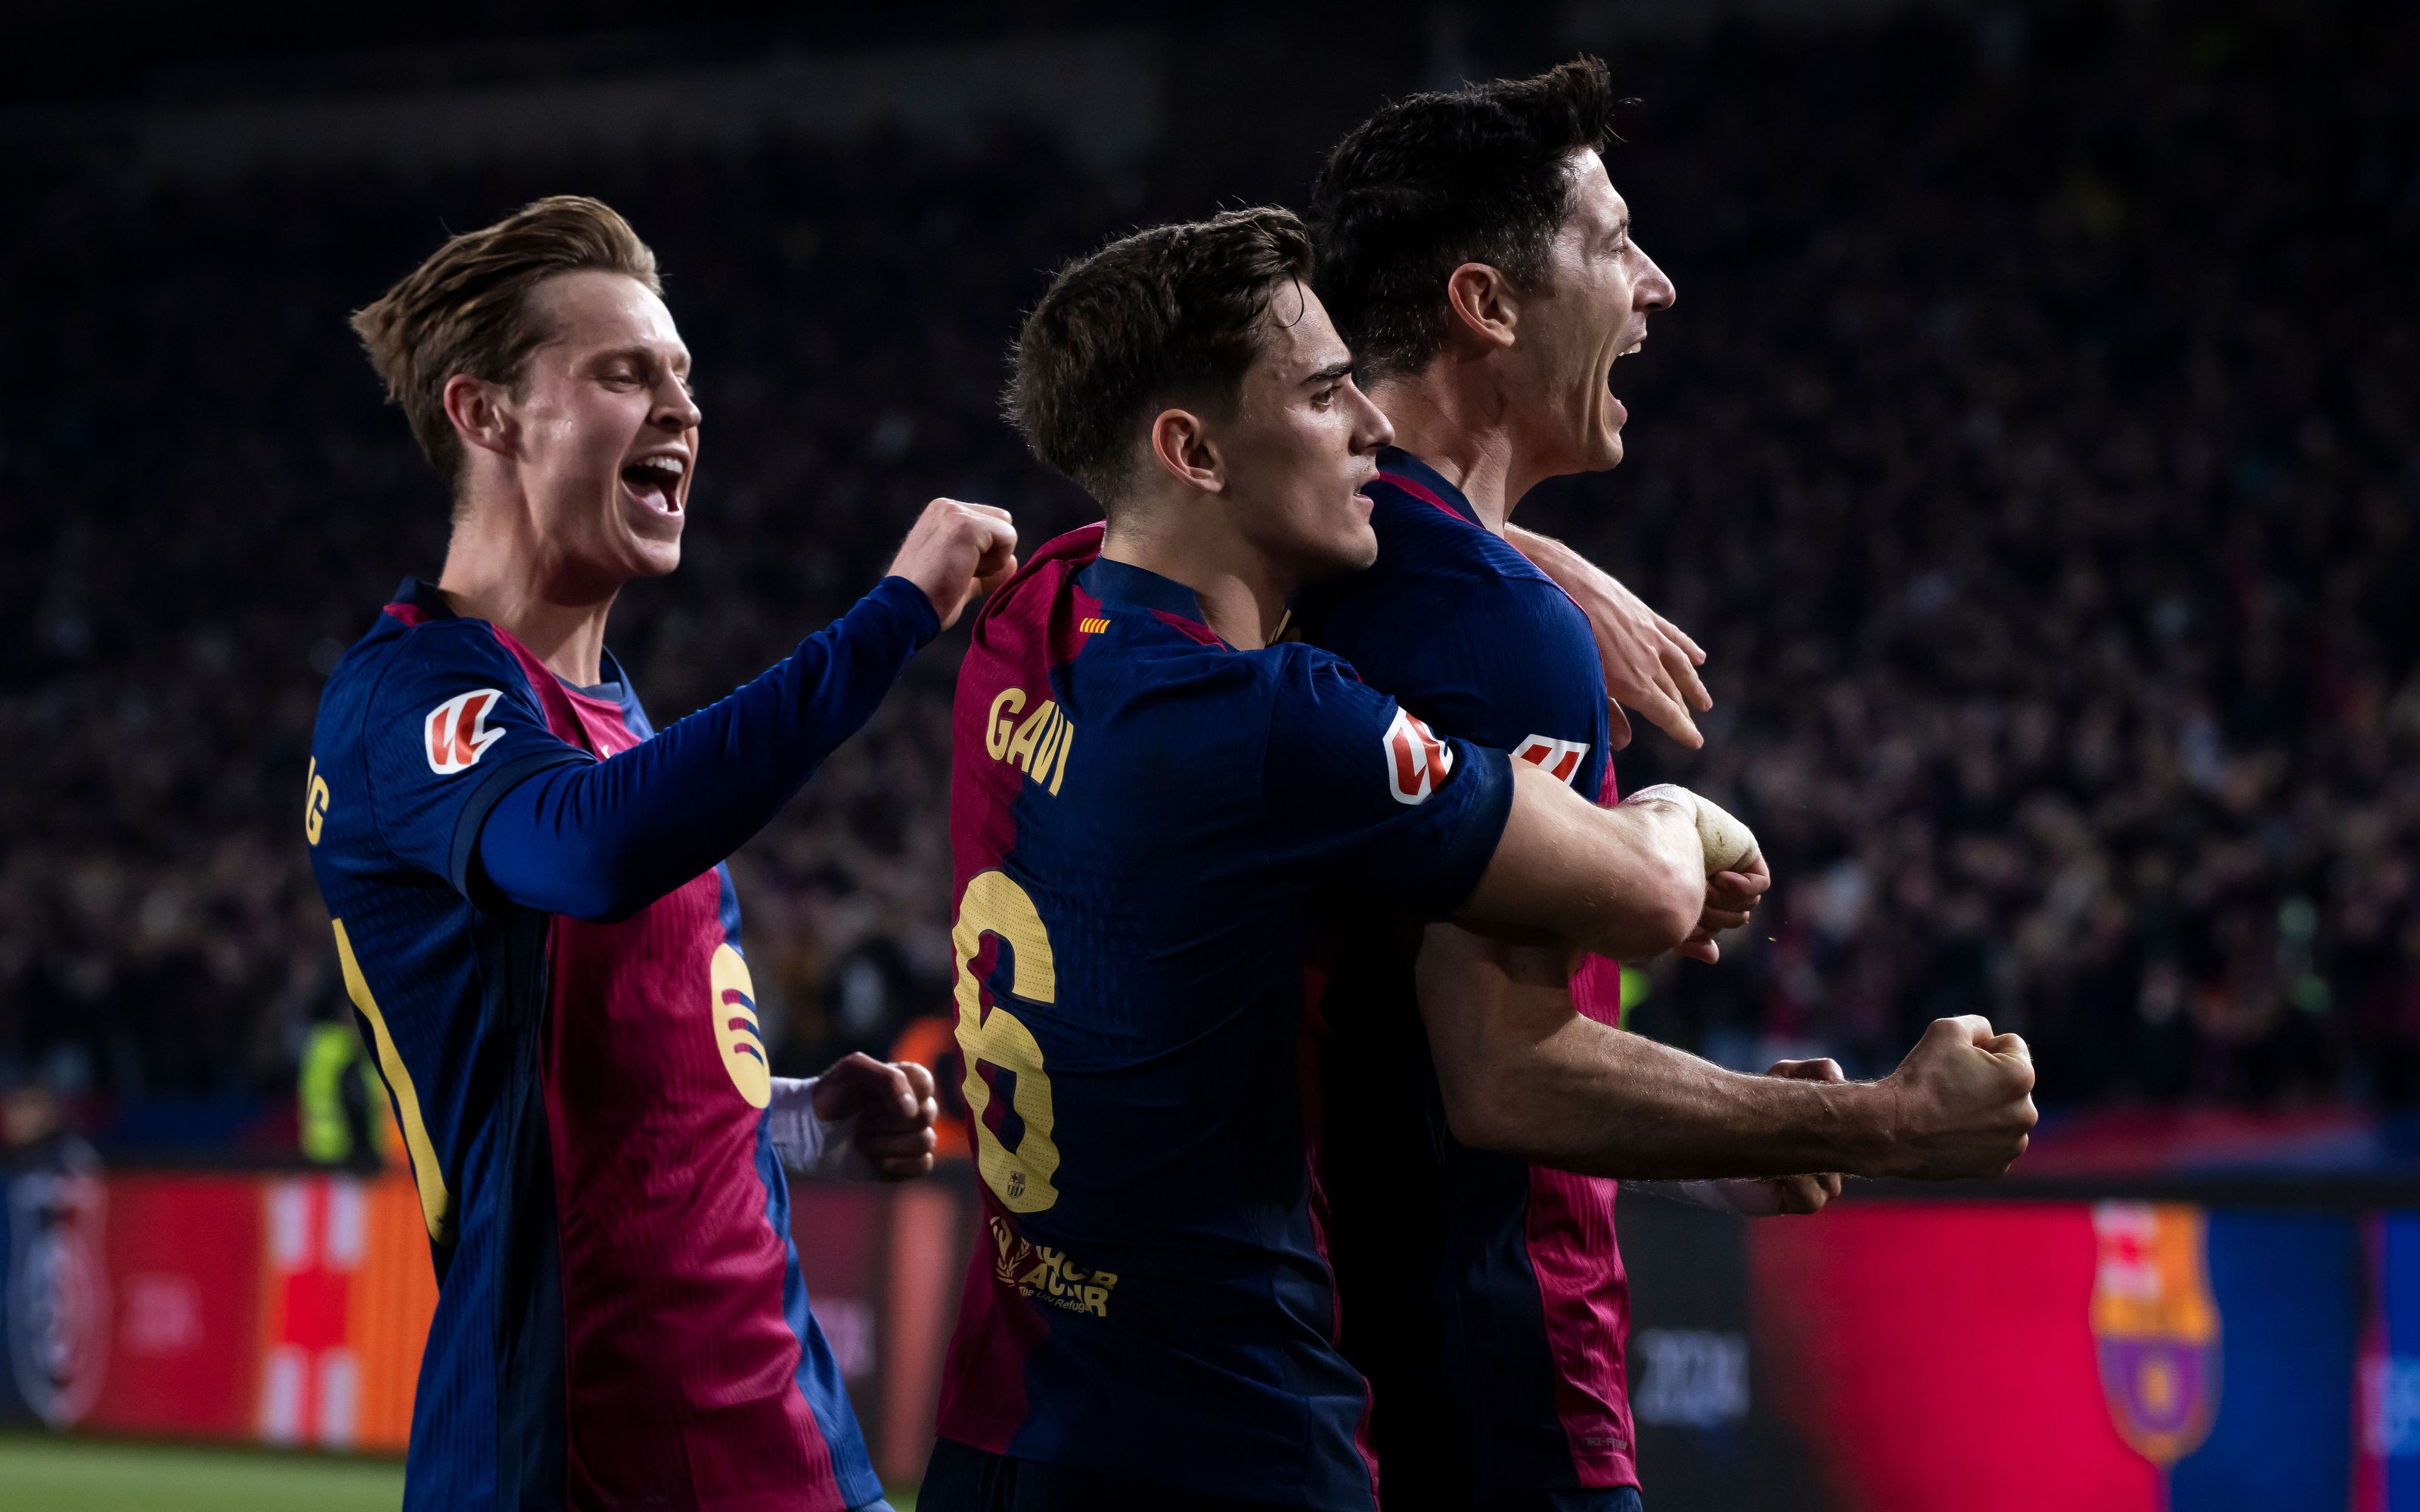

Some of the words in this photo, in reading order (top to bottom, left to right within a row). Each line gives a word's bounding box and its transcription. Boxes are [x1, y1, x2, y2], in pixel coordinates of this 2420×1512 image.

[985, 687, 1075, 798] GAVI
[951, 870, 1060, 1213] 6
[1019, 1285, 1035, 1297] The
